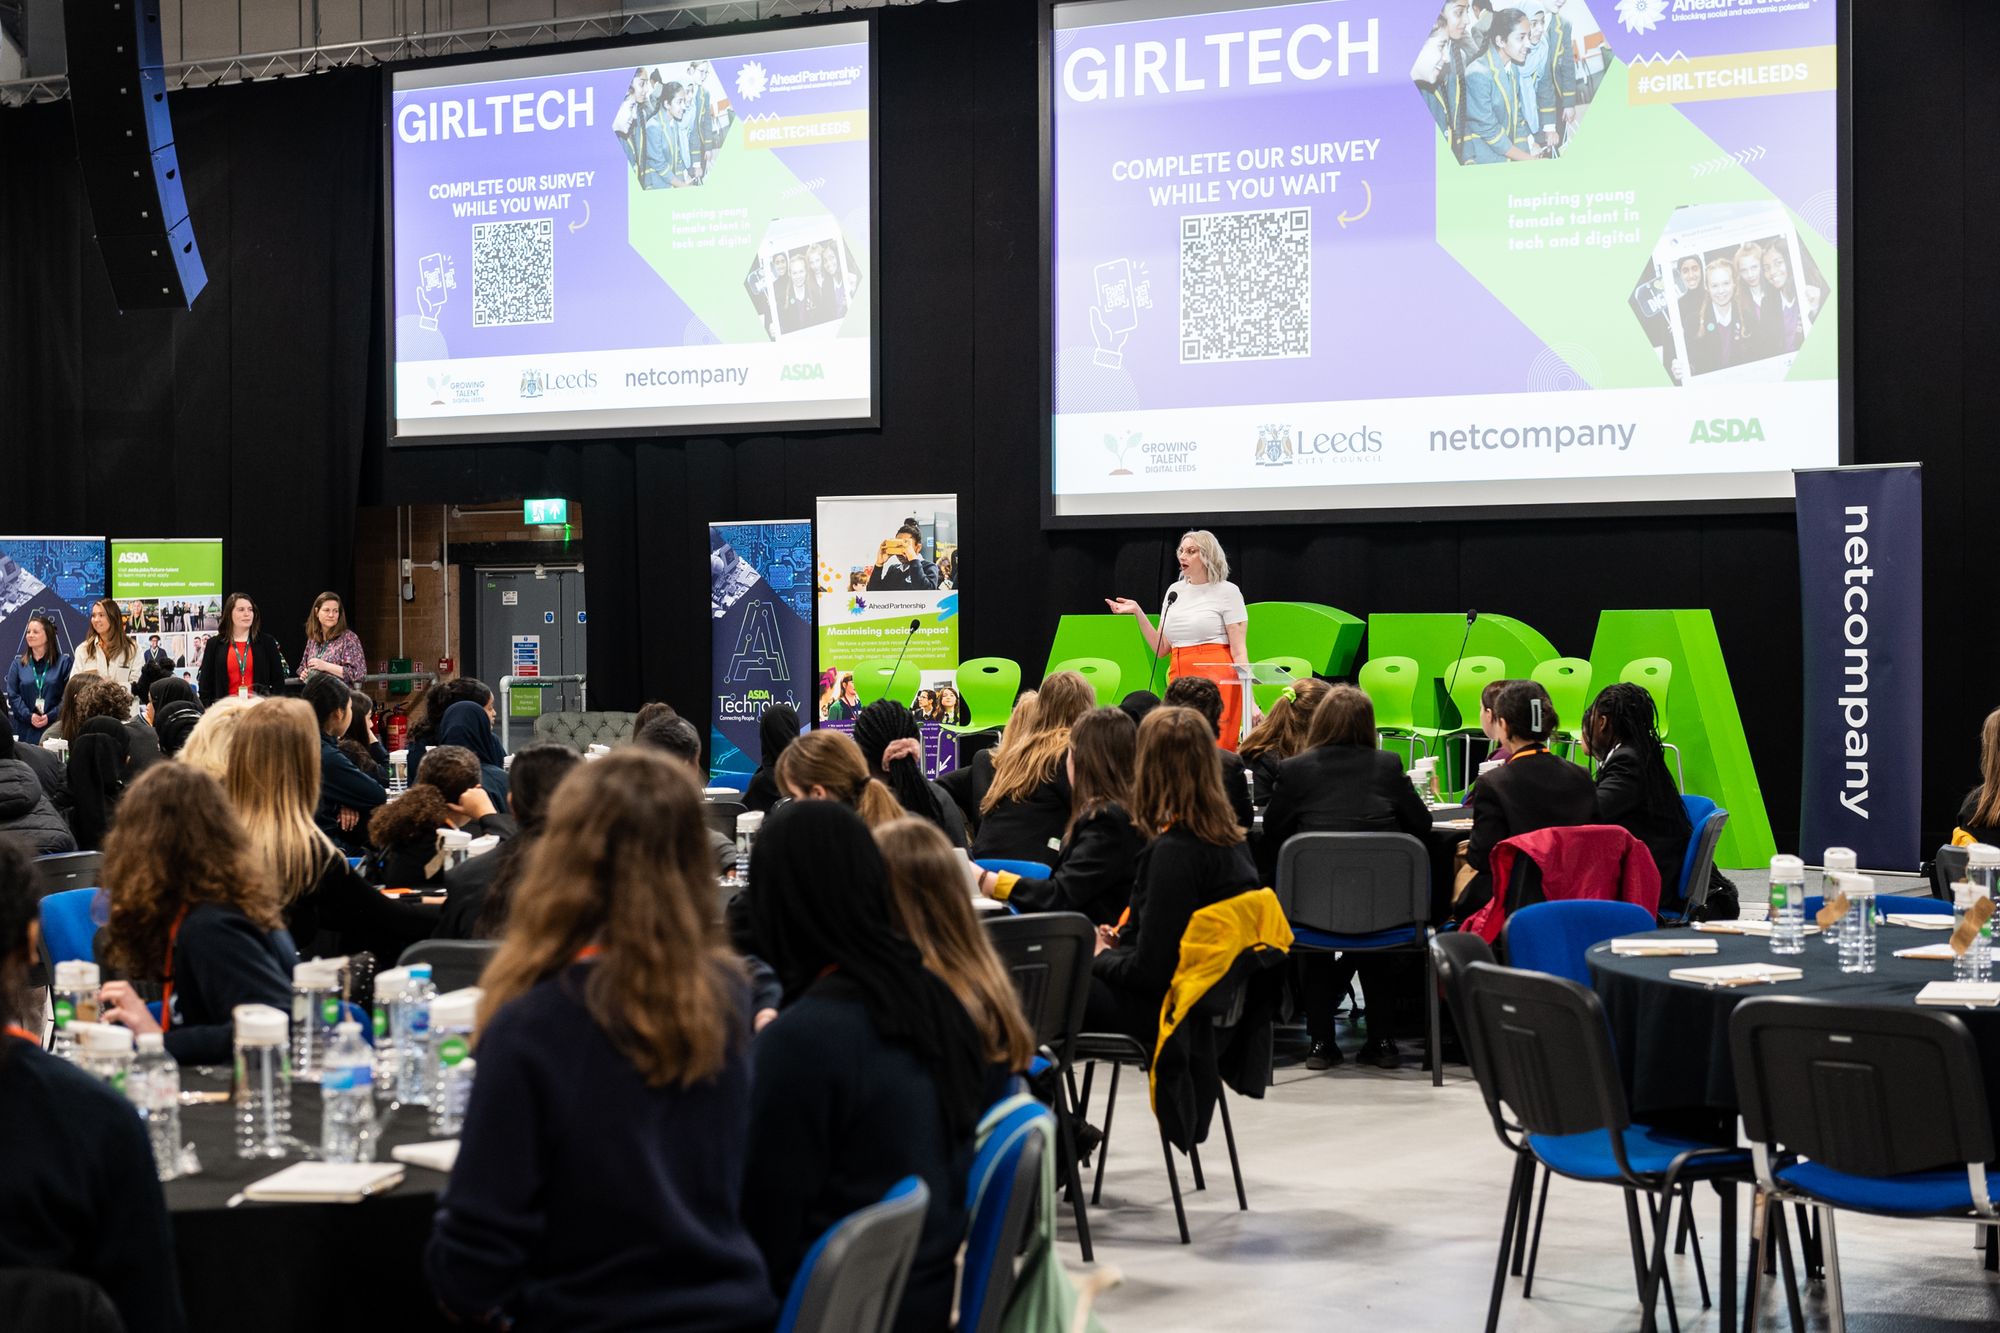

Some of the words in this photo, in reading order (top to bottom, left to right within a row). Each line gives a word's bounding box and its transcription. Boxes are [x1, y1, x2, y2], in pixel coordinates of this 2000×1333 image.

[1672, 11, 1706, 22] Unlocking
[1708, 9, 1728, 18] social
[1729, 8, 1742, 17] and
[1743, 5, 1777, 15] economic
[1062, 18, 1379, 102] GIRLTECH
[1638, 63, 1809, 94] #GIRLTECHLEEDS
[397, 86, 594, 143] GIRLTECH
[749, 121, 851, 142] #GIRLTECHLEEDS
[1112, 151, 1231, 181] COMPLETE
[1236, 146, 1285, 172] OUR
[1290, 138, 1381, 167] SURVEY
[429, 178, 503, 199] COMPLETE
[506, 176, 536, 193] OUR
[539, 171, 595, 190] SURVEY
[1148, 179, 1221, 207] WHILE
[1225, 175, 1275, 201] YOU
[1282, 171, 1341, 196] WAIT
[452, 199, 497, 218] WHILE
[500, 196, 531, 214] YOU
[533, 193, 571, 211] WAIT
[1508, 191, 1581, 212] Inspiring
[1585, 189, 1635, 208] young
[1508, 211, 1565, 229] female
[1569, 208, 1618, 225] talent
[1624, 207, 1640, 222] in
[1508, 234, 1544, 250] tech
[1549, 231, 1580, 248] and
[1585, 227, 1640, 249] digital
[546, 369, 598, 390] Leeds
[625, 367, 749, 388] netcompany
[779, 362, 825, 381] ASDA
[450, 380, 485, 390] GROWING
[456, 389, 479, 397] TALENT
[1297, 425, 1382, 455] Leeds
[1429, 419, 1636, 453] netcompany
[1689, 416, 1766, 445] ASDA
[1141, 441, 1197, 454] GROWING
[1145, 465, 1173, 474] DIGITAL
[1174, 464, 1196, 473] LEEDS
[1151, 453, 1188, 465] TALENT
[1297, 457, 1324, 465] CITY
[1332, 455, 1383, 464] COUNCIL
[118, 552, 149, 564] ASDA
[827, 627, 882, 637] Maximising
[884, 627, 912, 636] socia
[1838, 505, 1874, 820] netcompany
[718, 691, 801, 713] Technoly
[747, 689, 770, 700] ASDA
